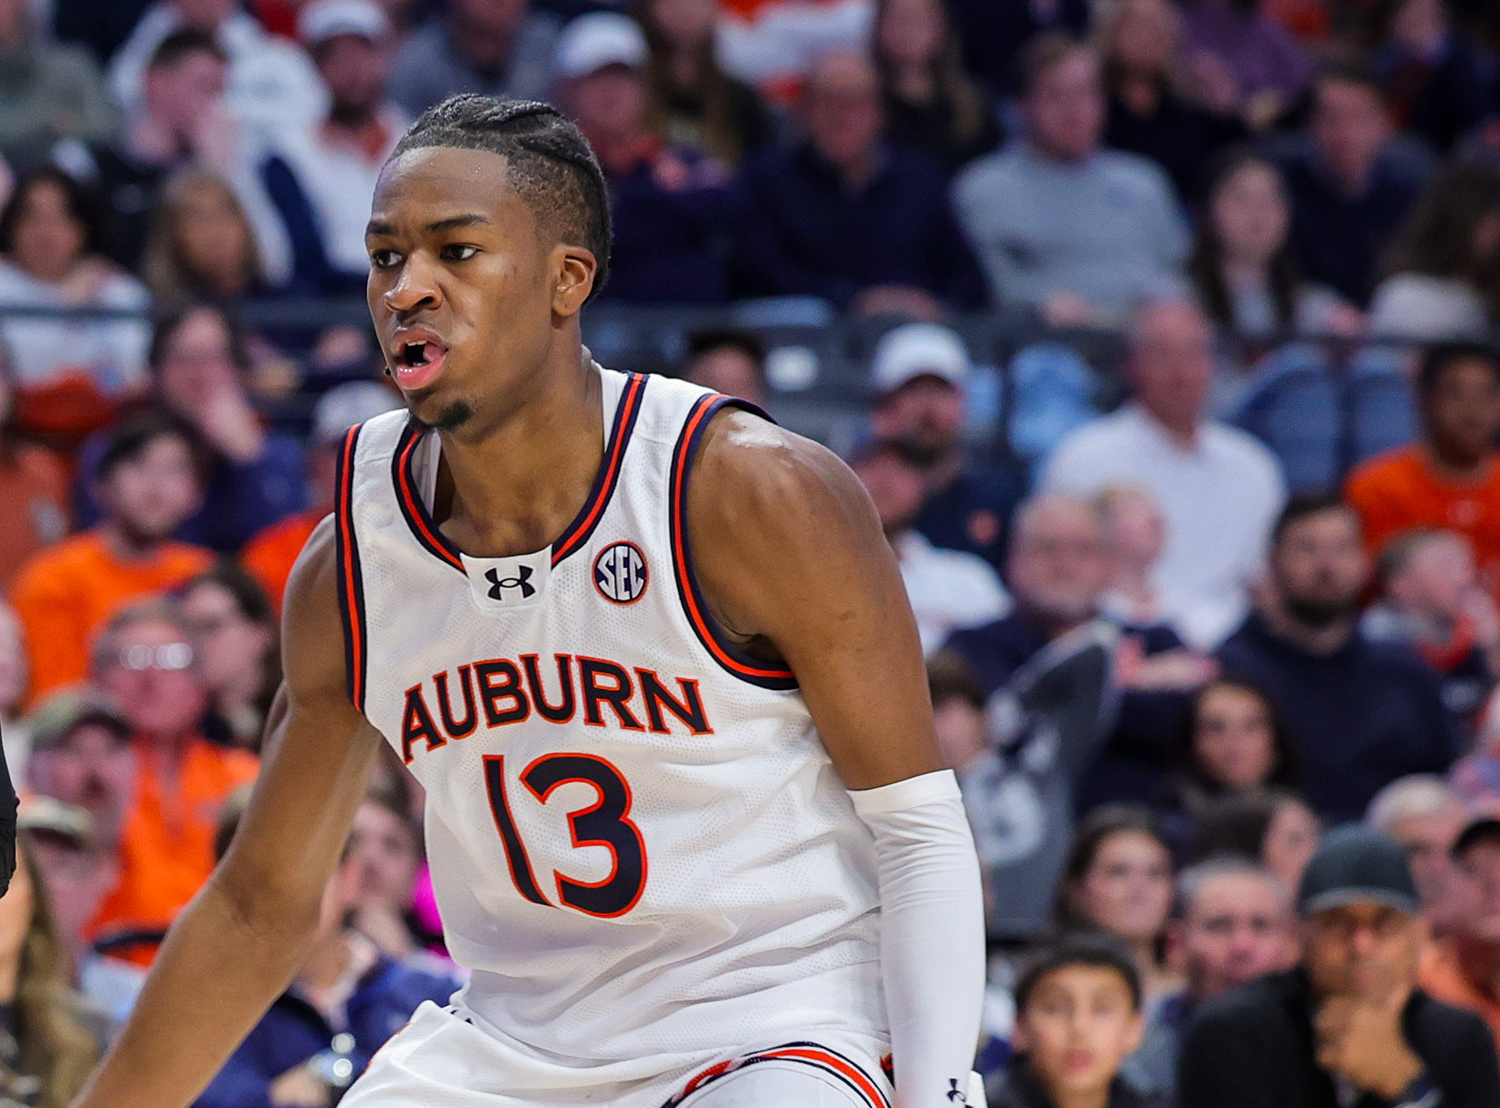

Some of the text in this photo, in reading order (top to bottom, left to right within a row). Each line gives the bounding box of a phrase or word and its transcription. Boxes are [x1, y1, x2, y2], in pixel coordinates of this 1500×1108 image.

[597, 545, 646, 601] SEC
[402, 653, 714, 765] AUBURN
[482, 752, 648, 918] 13
